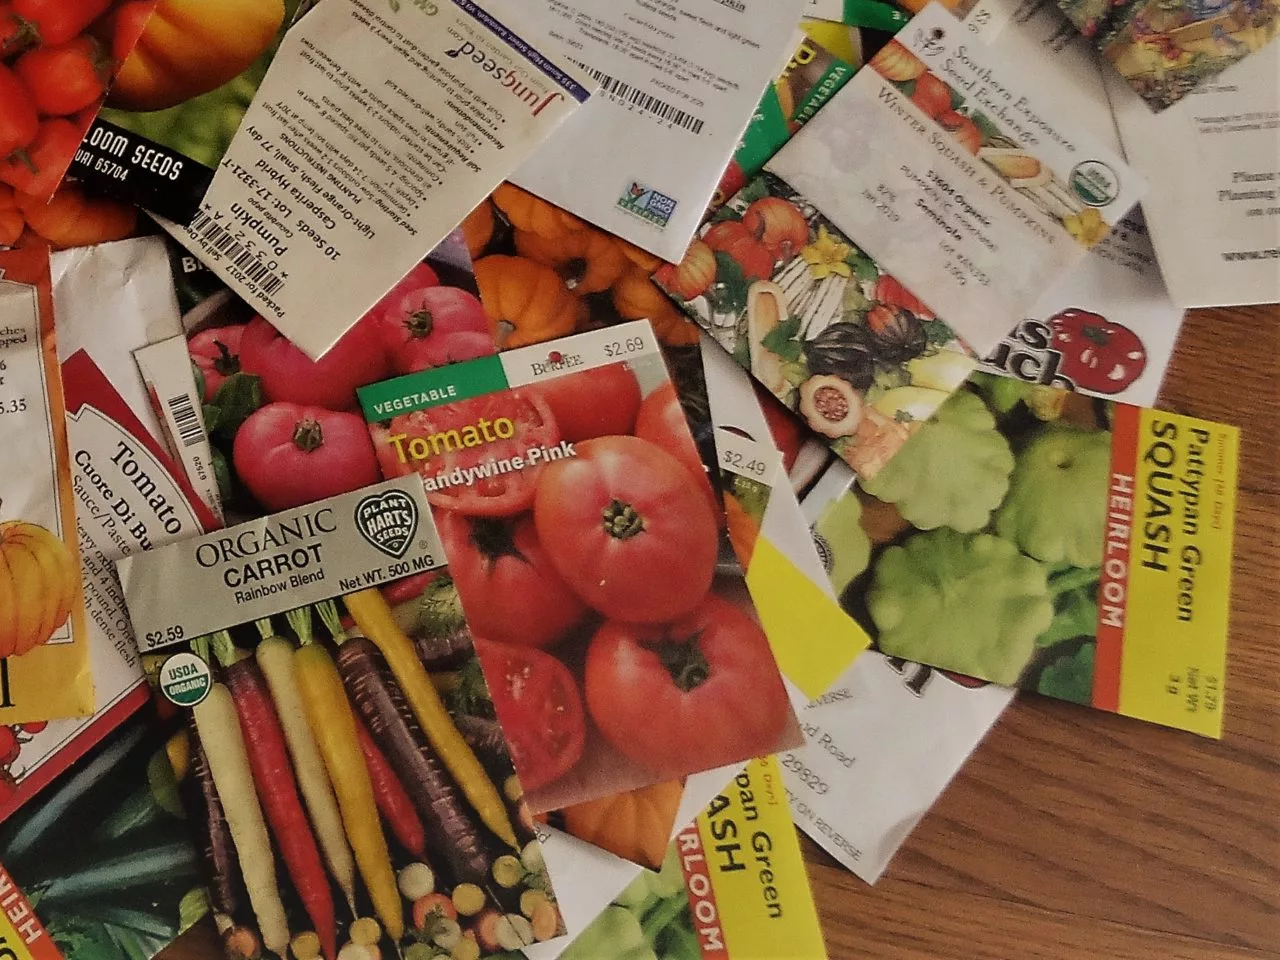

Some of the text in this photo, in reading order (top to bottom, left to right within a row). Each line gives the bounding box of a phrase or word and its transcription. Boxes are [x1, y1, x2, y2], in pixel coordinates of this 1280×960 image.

[939, 57, 1043, 149] Seed Exchange
[950, 43, 1079, 155] Southern Exposure
[93, 158, 131, 183] 65704
[132, 136, 183, 181] SEEDS
[245, 124, 376, 240] Light-Orange Flesh, Small, 77 day
[222, 156, 340, 261] 10 Seeds Lot: 17-3321-T
[255, 157, 337, 231] Casperita Hybrid
[227, 200, 290, 257] Pumpkin
[913, 198, 964, 242] Seminole
[531, 337, 645, 377] BURPEE $2.69
[373, 385, 458, 415] VEGETABLE
[388, 416, 516, 465] Tomato
[723, 449, 768, 477] $2.49
[75, 448, 114, 501] Cuore
[112, 496, 132, 529] Di
[110, 440, 183, 537] Tomato
[422, 441, 577, 494] andywine Pink
[72, 477, 131, 555] Sauce/Paste
[363, 498, 407, 519] PLANT
[1140, 421, 1177, 574] SQUASH
[195, 507, 337, 569] ORGANIC
[376, 527, 410, 546] SEEDS
[1176, 428, 1211, 623] Pattypan Green
[224, 544, 323, 589] CARROT
[338, 554, 435, 592] Net WT. 500 MG
[1103, 474, 1135, 628] HEIRLOOM
[234, 568, 325, 606] Rainbow Blend
[146, 625, 184, 649] $2.59
[168, 678, 207, 697] ORGANIC
[169, 664, 199, 681] USDA
[782, 753, 831, 796] 29829
[818, 733, 858, 769] Road
[751, 831, 782, 919] Green
